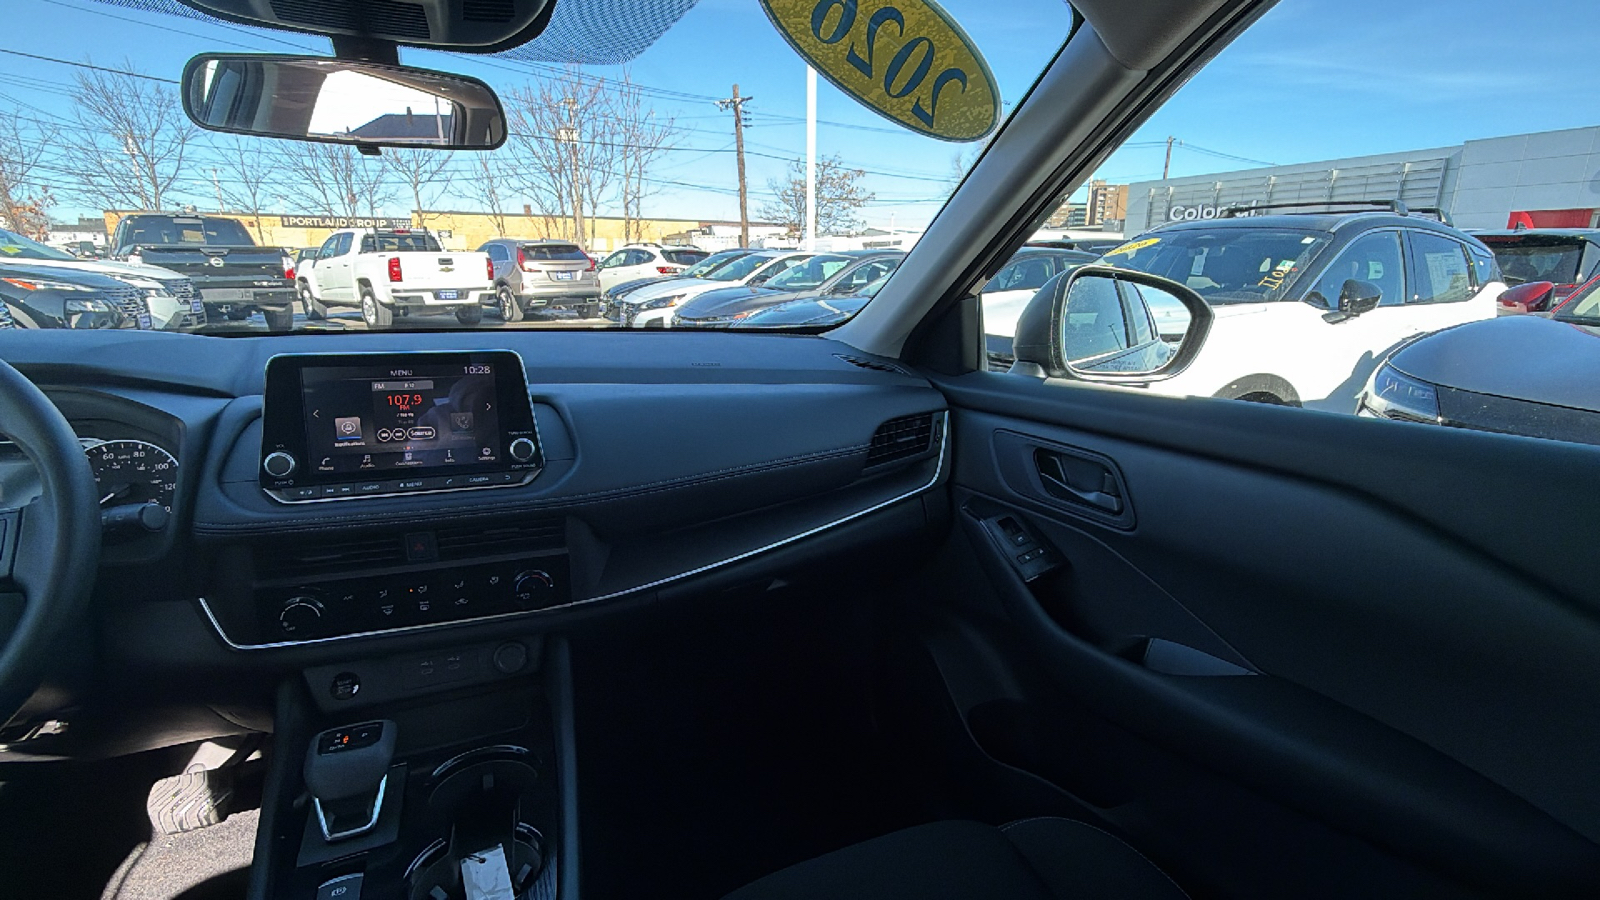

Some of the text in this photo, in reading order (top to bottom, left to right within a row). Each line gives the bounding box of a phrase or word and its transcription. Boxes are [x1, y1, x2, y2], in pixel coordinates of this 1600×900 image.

[290, 217, 347, 227] PORTLAND
[390, 369, 413, 377] MENU
[463, 365, 491, 375] 10:28
[387, 394, 422, 406] 107.9
